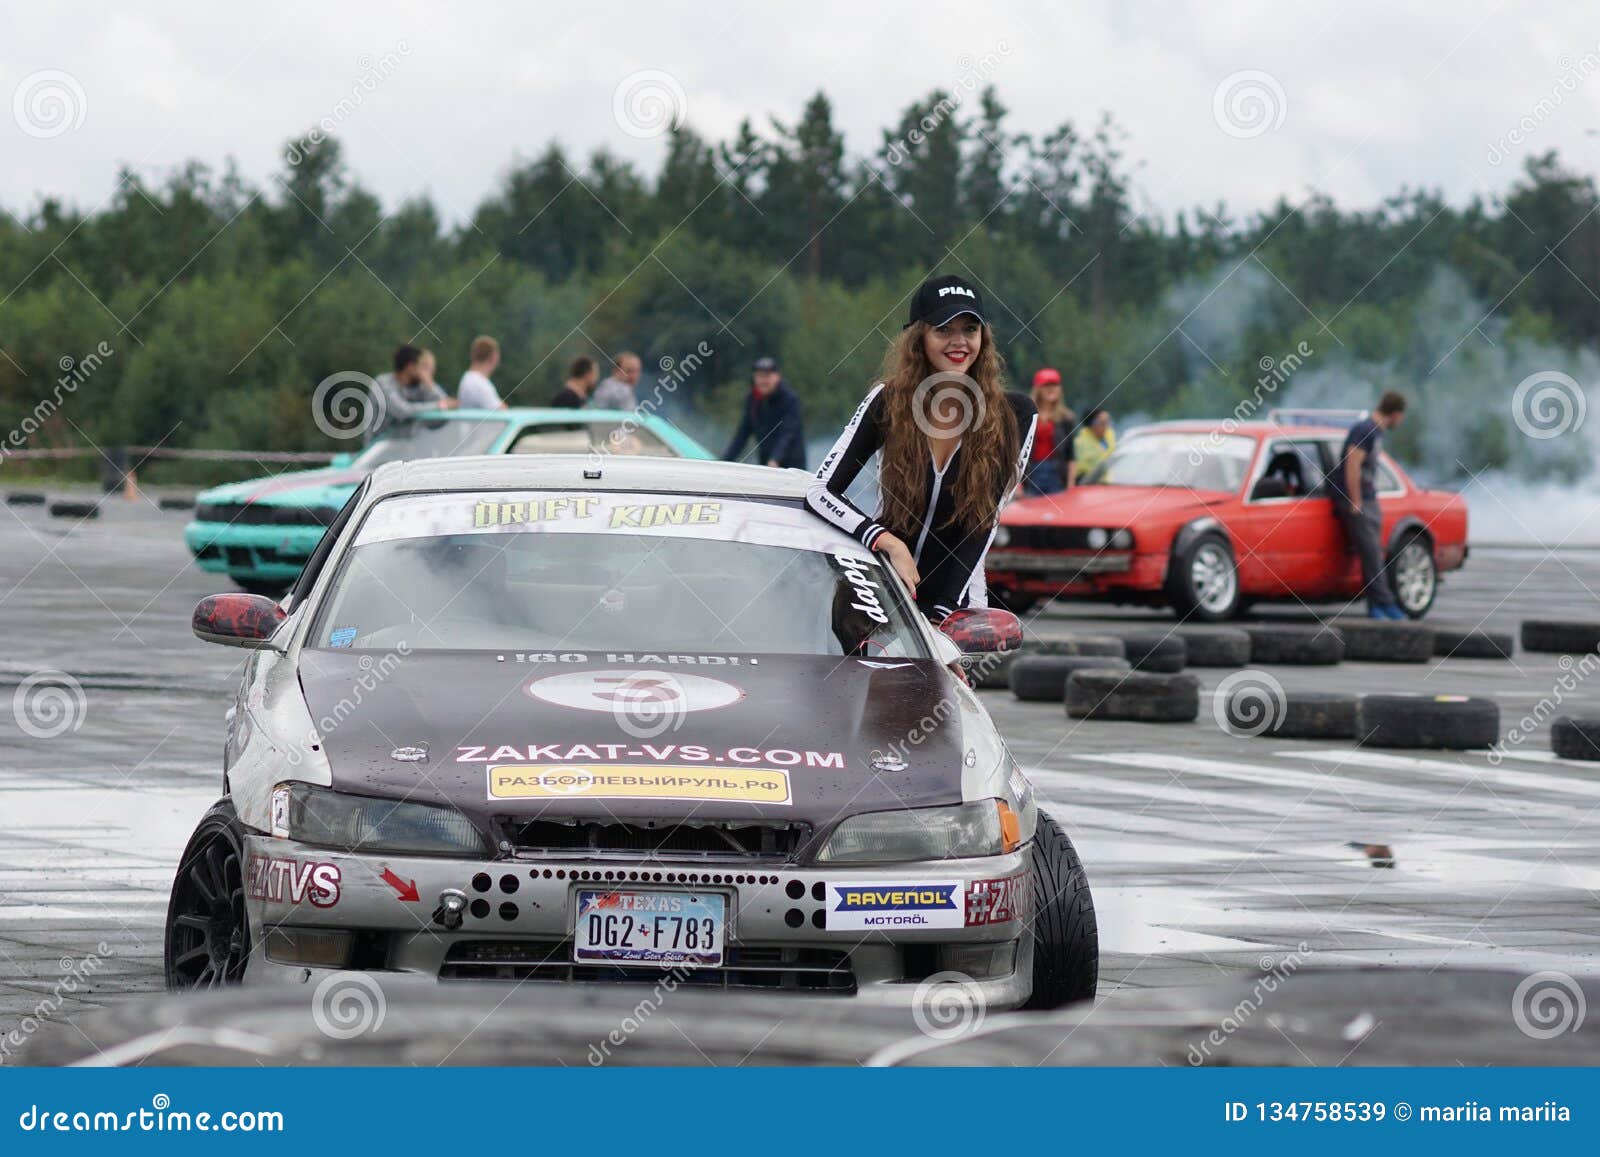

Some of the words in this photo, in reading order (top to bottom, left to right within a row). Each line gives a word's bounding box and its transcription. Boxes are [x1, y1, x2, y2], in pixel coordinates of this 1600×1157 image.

[938, 286, 976, 299] PIAA
[817, 451, 839, 480] PIAA
[473, 497, 600, 529] DRIFT
[610, 502, 722, 529] KING
[819, 495, 846, 518] PIAA
[606, 654, 740, 666] HARD!
[592, 677, 680, 703] 3
[455, 743, 845, 769] ZAKAT-VS.COM
[498, 774, 779, 792] РАЗБОРЛЕВЫЙРУЛЬ.РФ
[619, 895, 682, 912] TEXAS
[846, 890, 947, 906] RAVENOL
[864, 914, 929, 926] MOTORÖL
[588, 914, 635, 948] DG2
[653, 916, 715, 950] F783
[623, 950, 642, 960] Lone
[643, 951, 662, 960] Star
[663, 952, 685, 961] State
